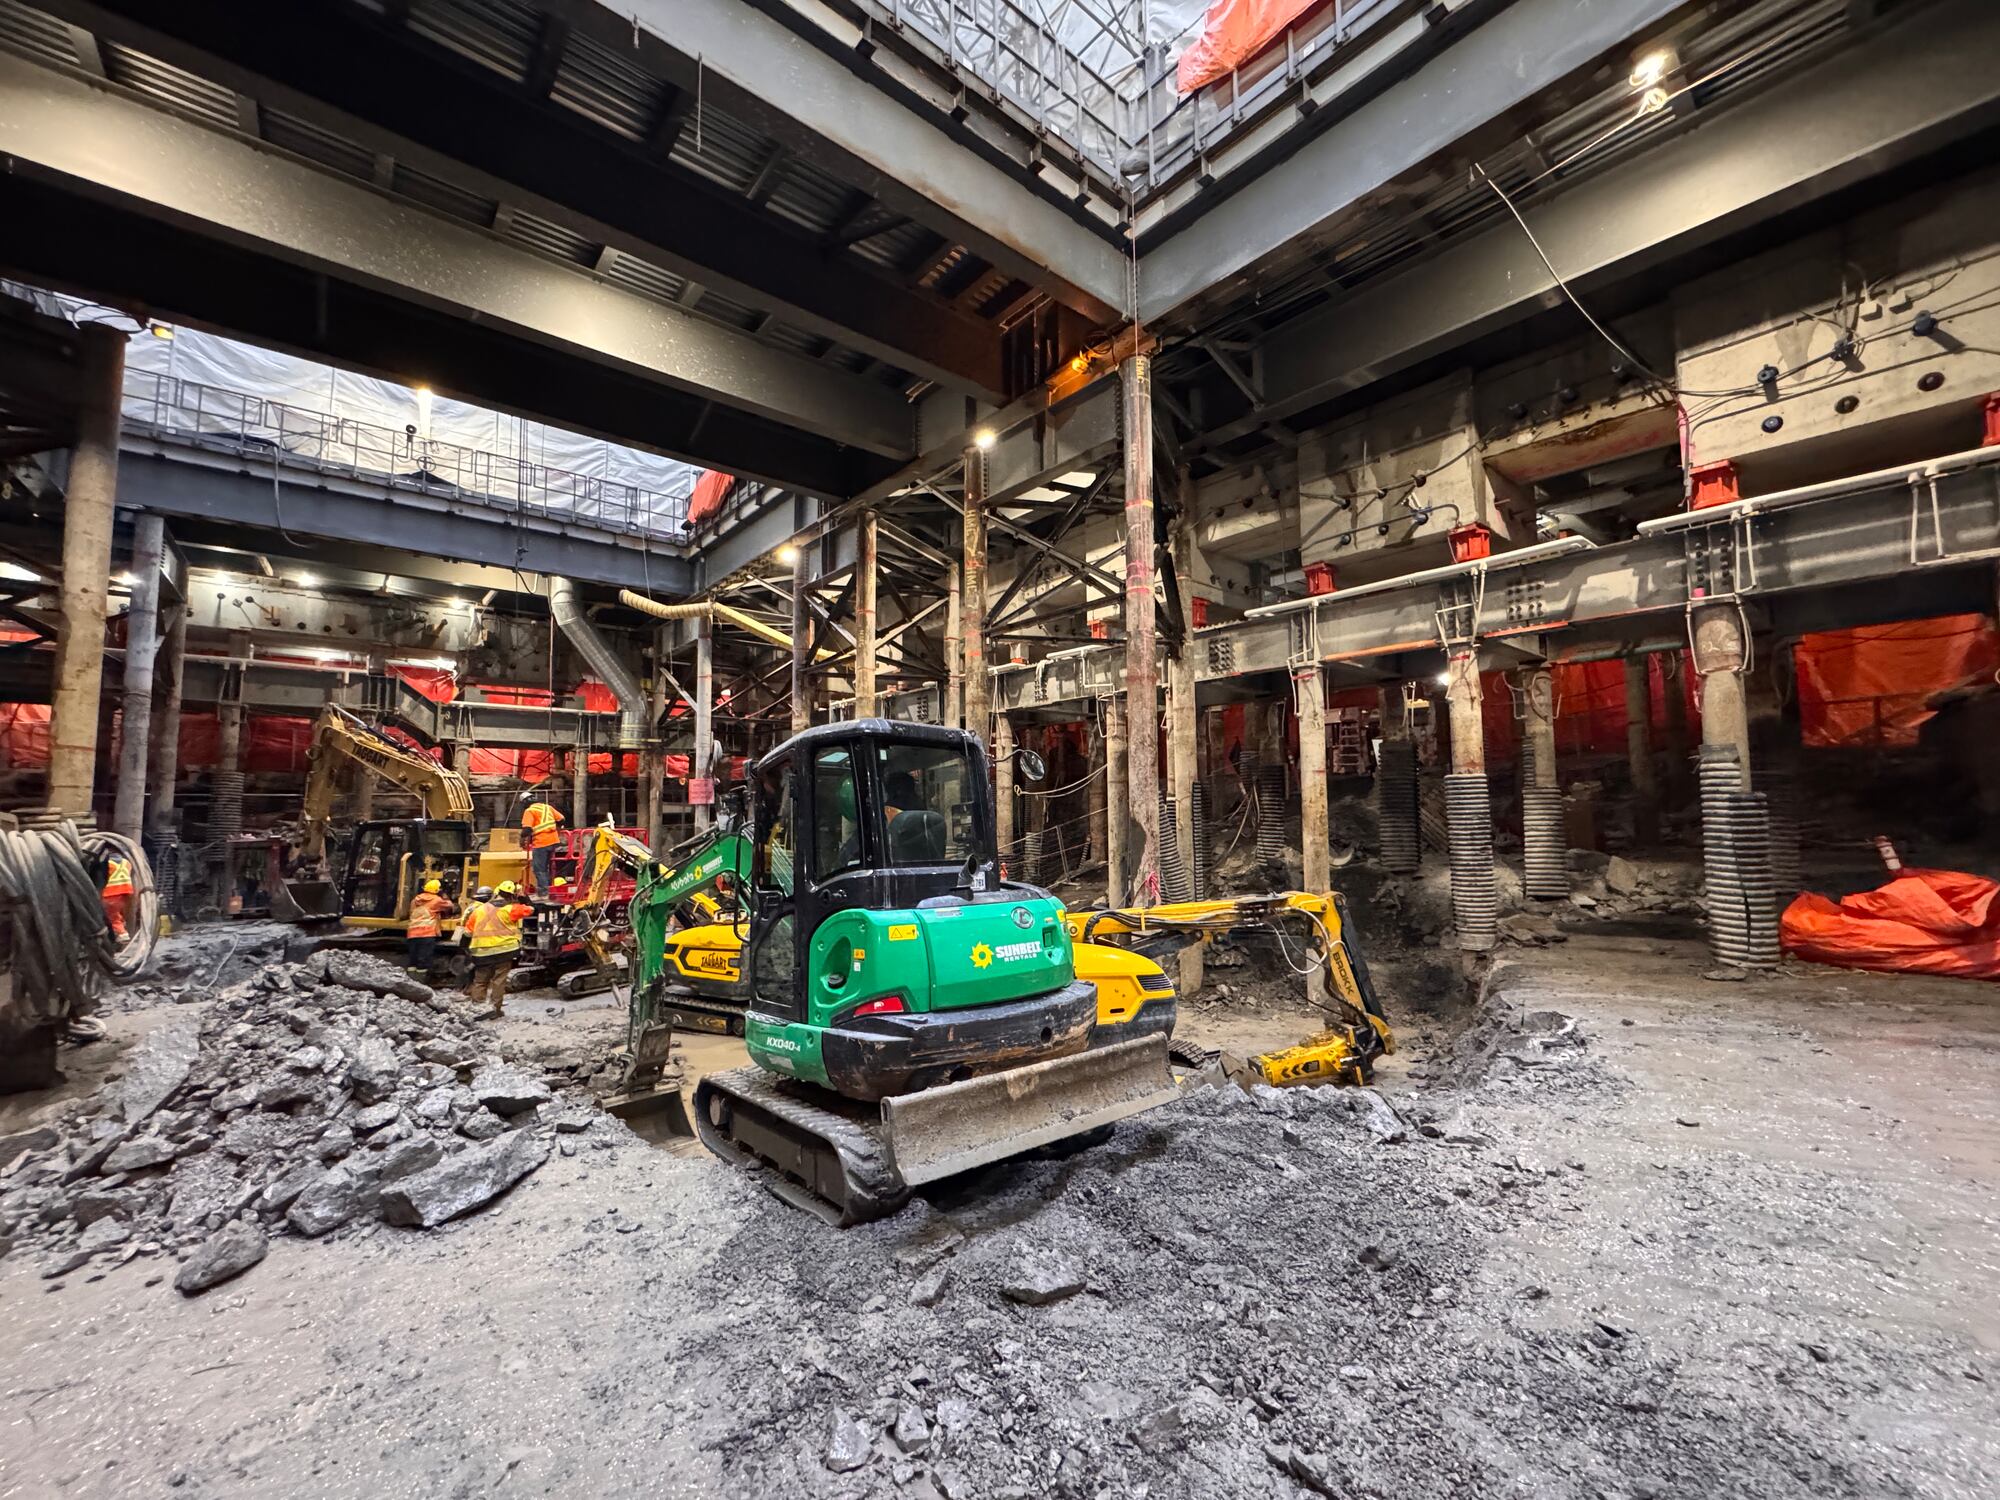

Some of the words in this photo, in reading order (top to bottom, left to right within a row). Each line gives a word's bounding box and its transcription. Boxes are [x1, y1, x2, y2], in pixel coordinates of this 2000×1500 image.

[1135, 357, 1145, 384] HMC
[965, 509, 977, 537] HMC
[965, 567, 977, 594] HMC
[352, 743, 390, 769] TAGGART
[671, 872, 694, 891] Kubota
[701, 952, 727, 970] TAGGART
[995, 941, 1042, 959] SUNBELT
[1004, 953, 1038, 962] RENTALS
[1333, 951, 1354, 994] BROKK
[766, 1036, 801, 1052] KX040-4
